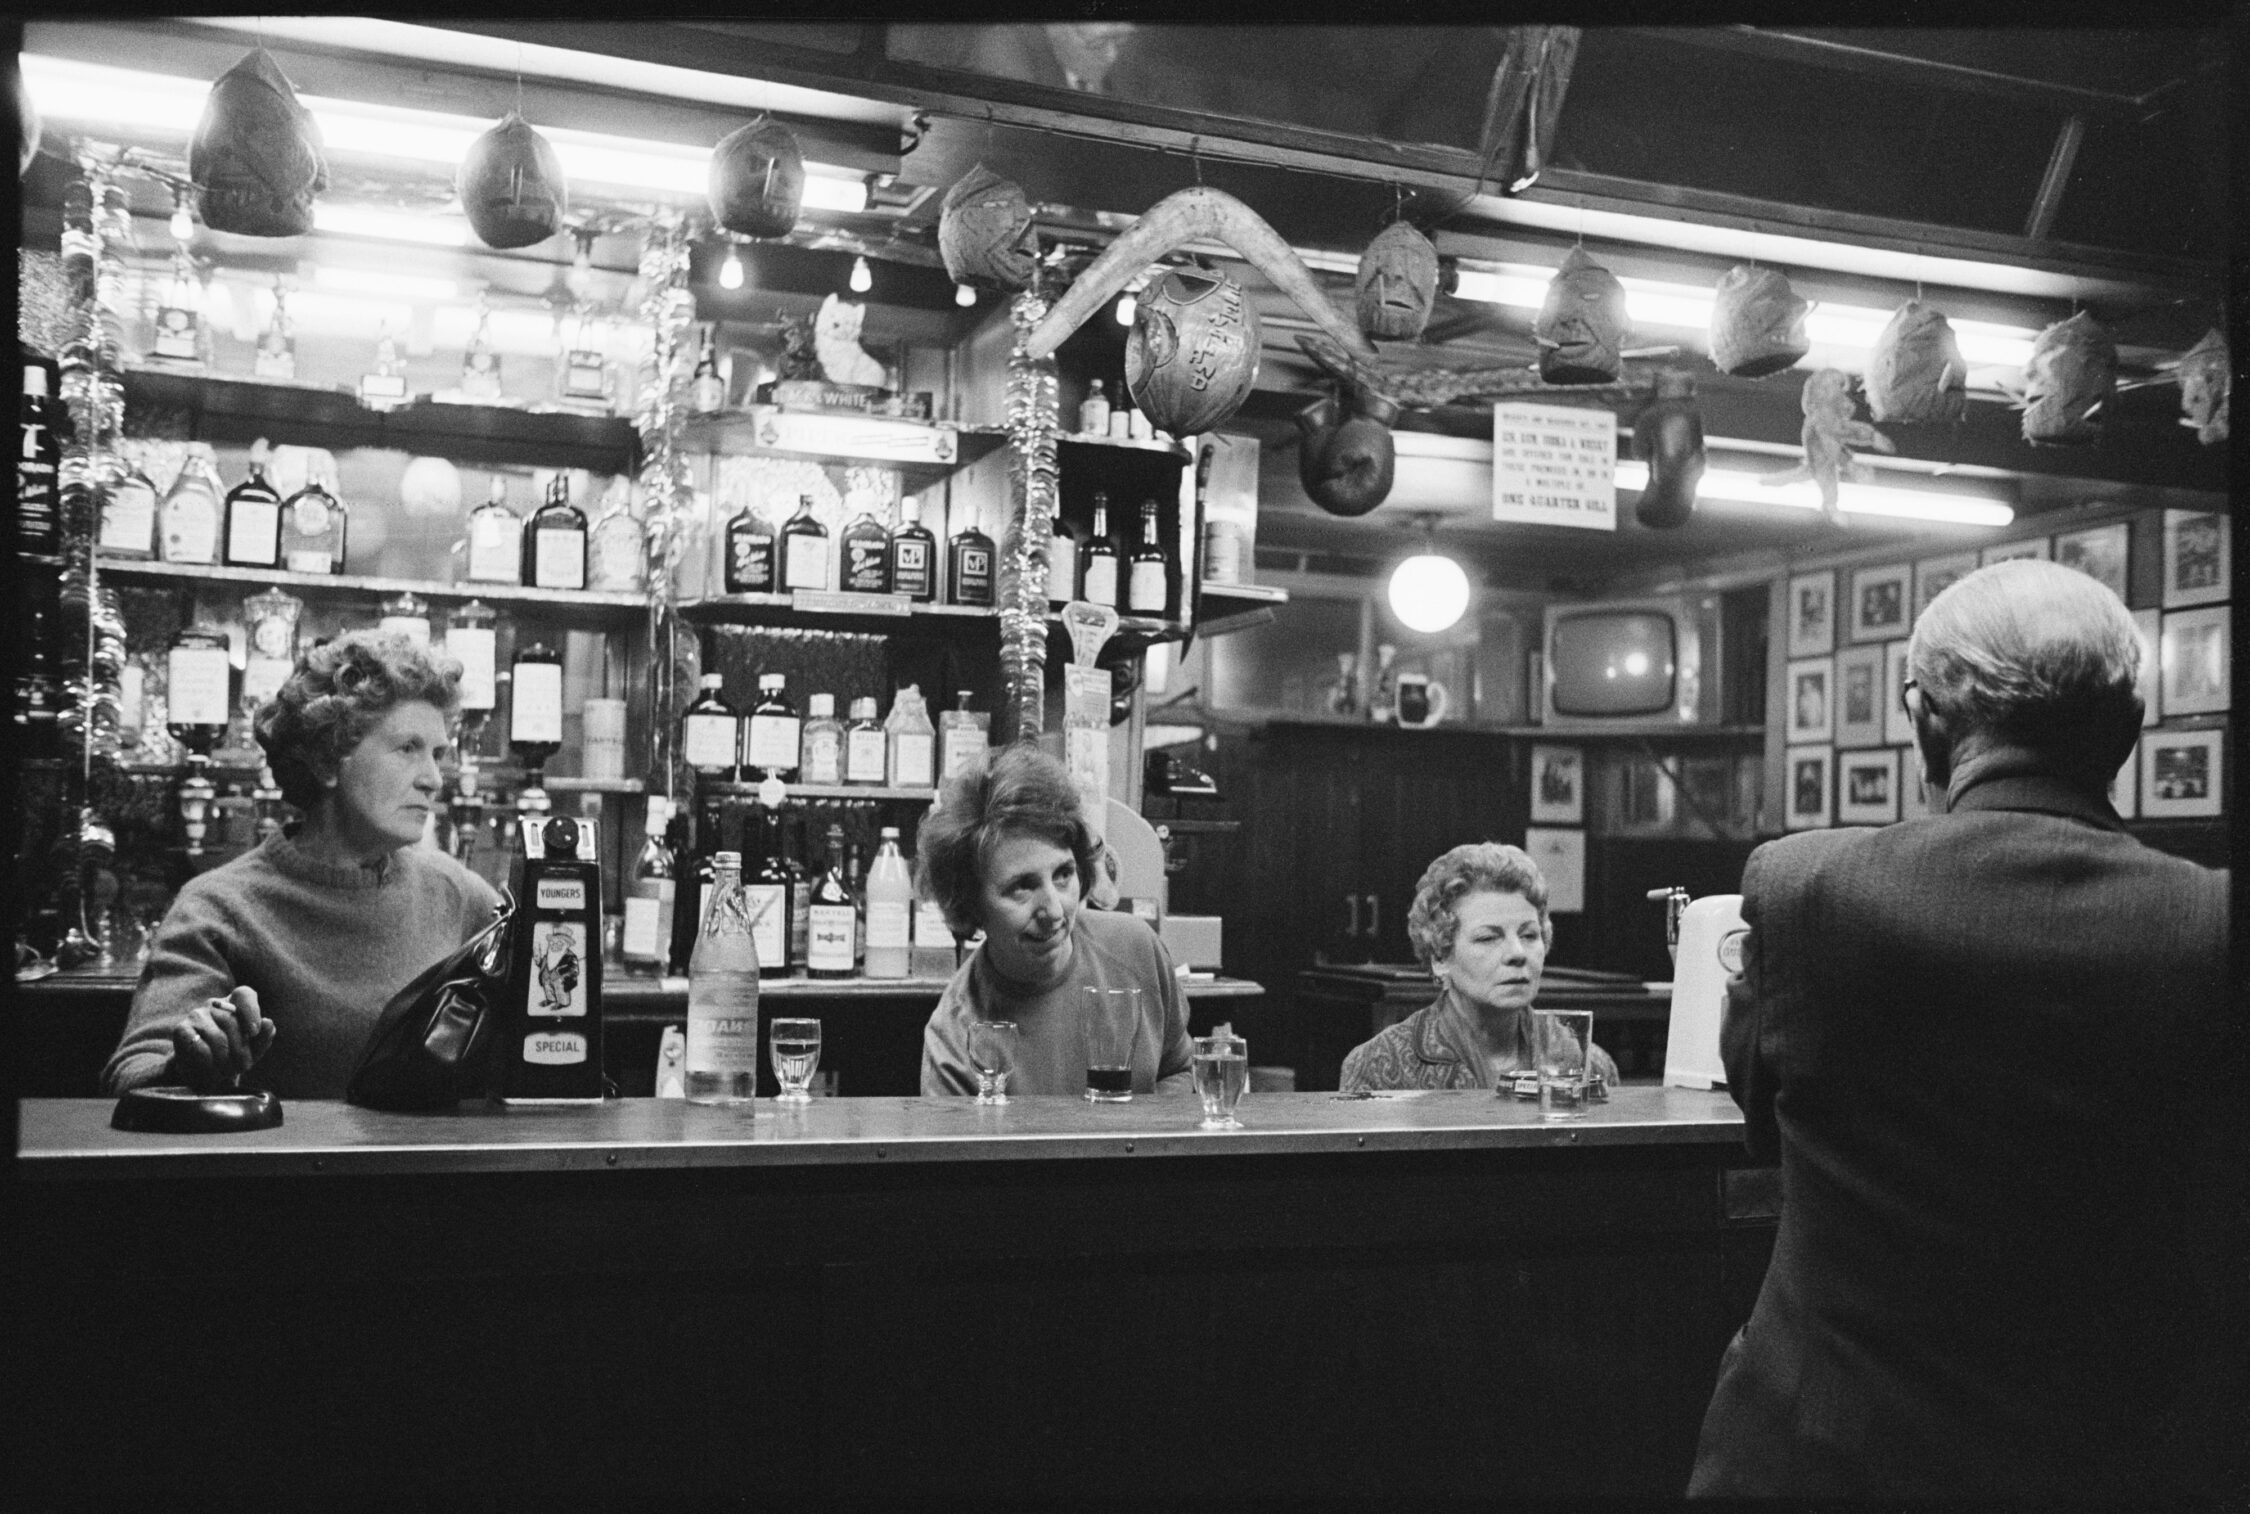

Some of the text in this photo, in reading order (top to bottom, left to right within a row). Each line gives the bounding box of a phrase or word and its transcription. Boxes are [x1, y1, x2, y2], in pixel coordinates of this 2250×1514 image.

[824, 393, 868, 407] WHITE
[1502, 493, 1524, 506] ONE
[1529, 495, 1580, 510] QUARTER
[540, 887, 581, 899] YOUNGERS
[535, 1040, 580, 1053] SPECIAL
